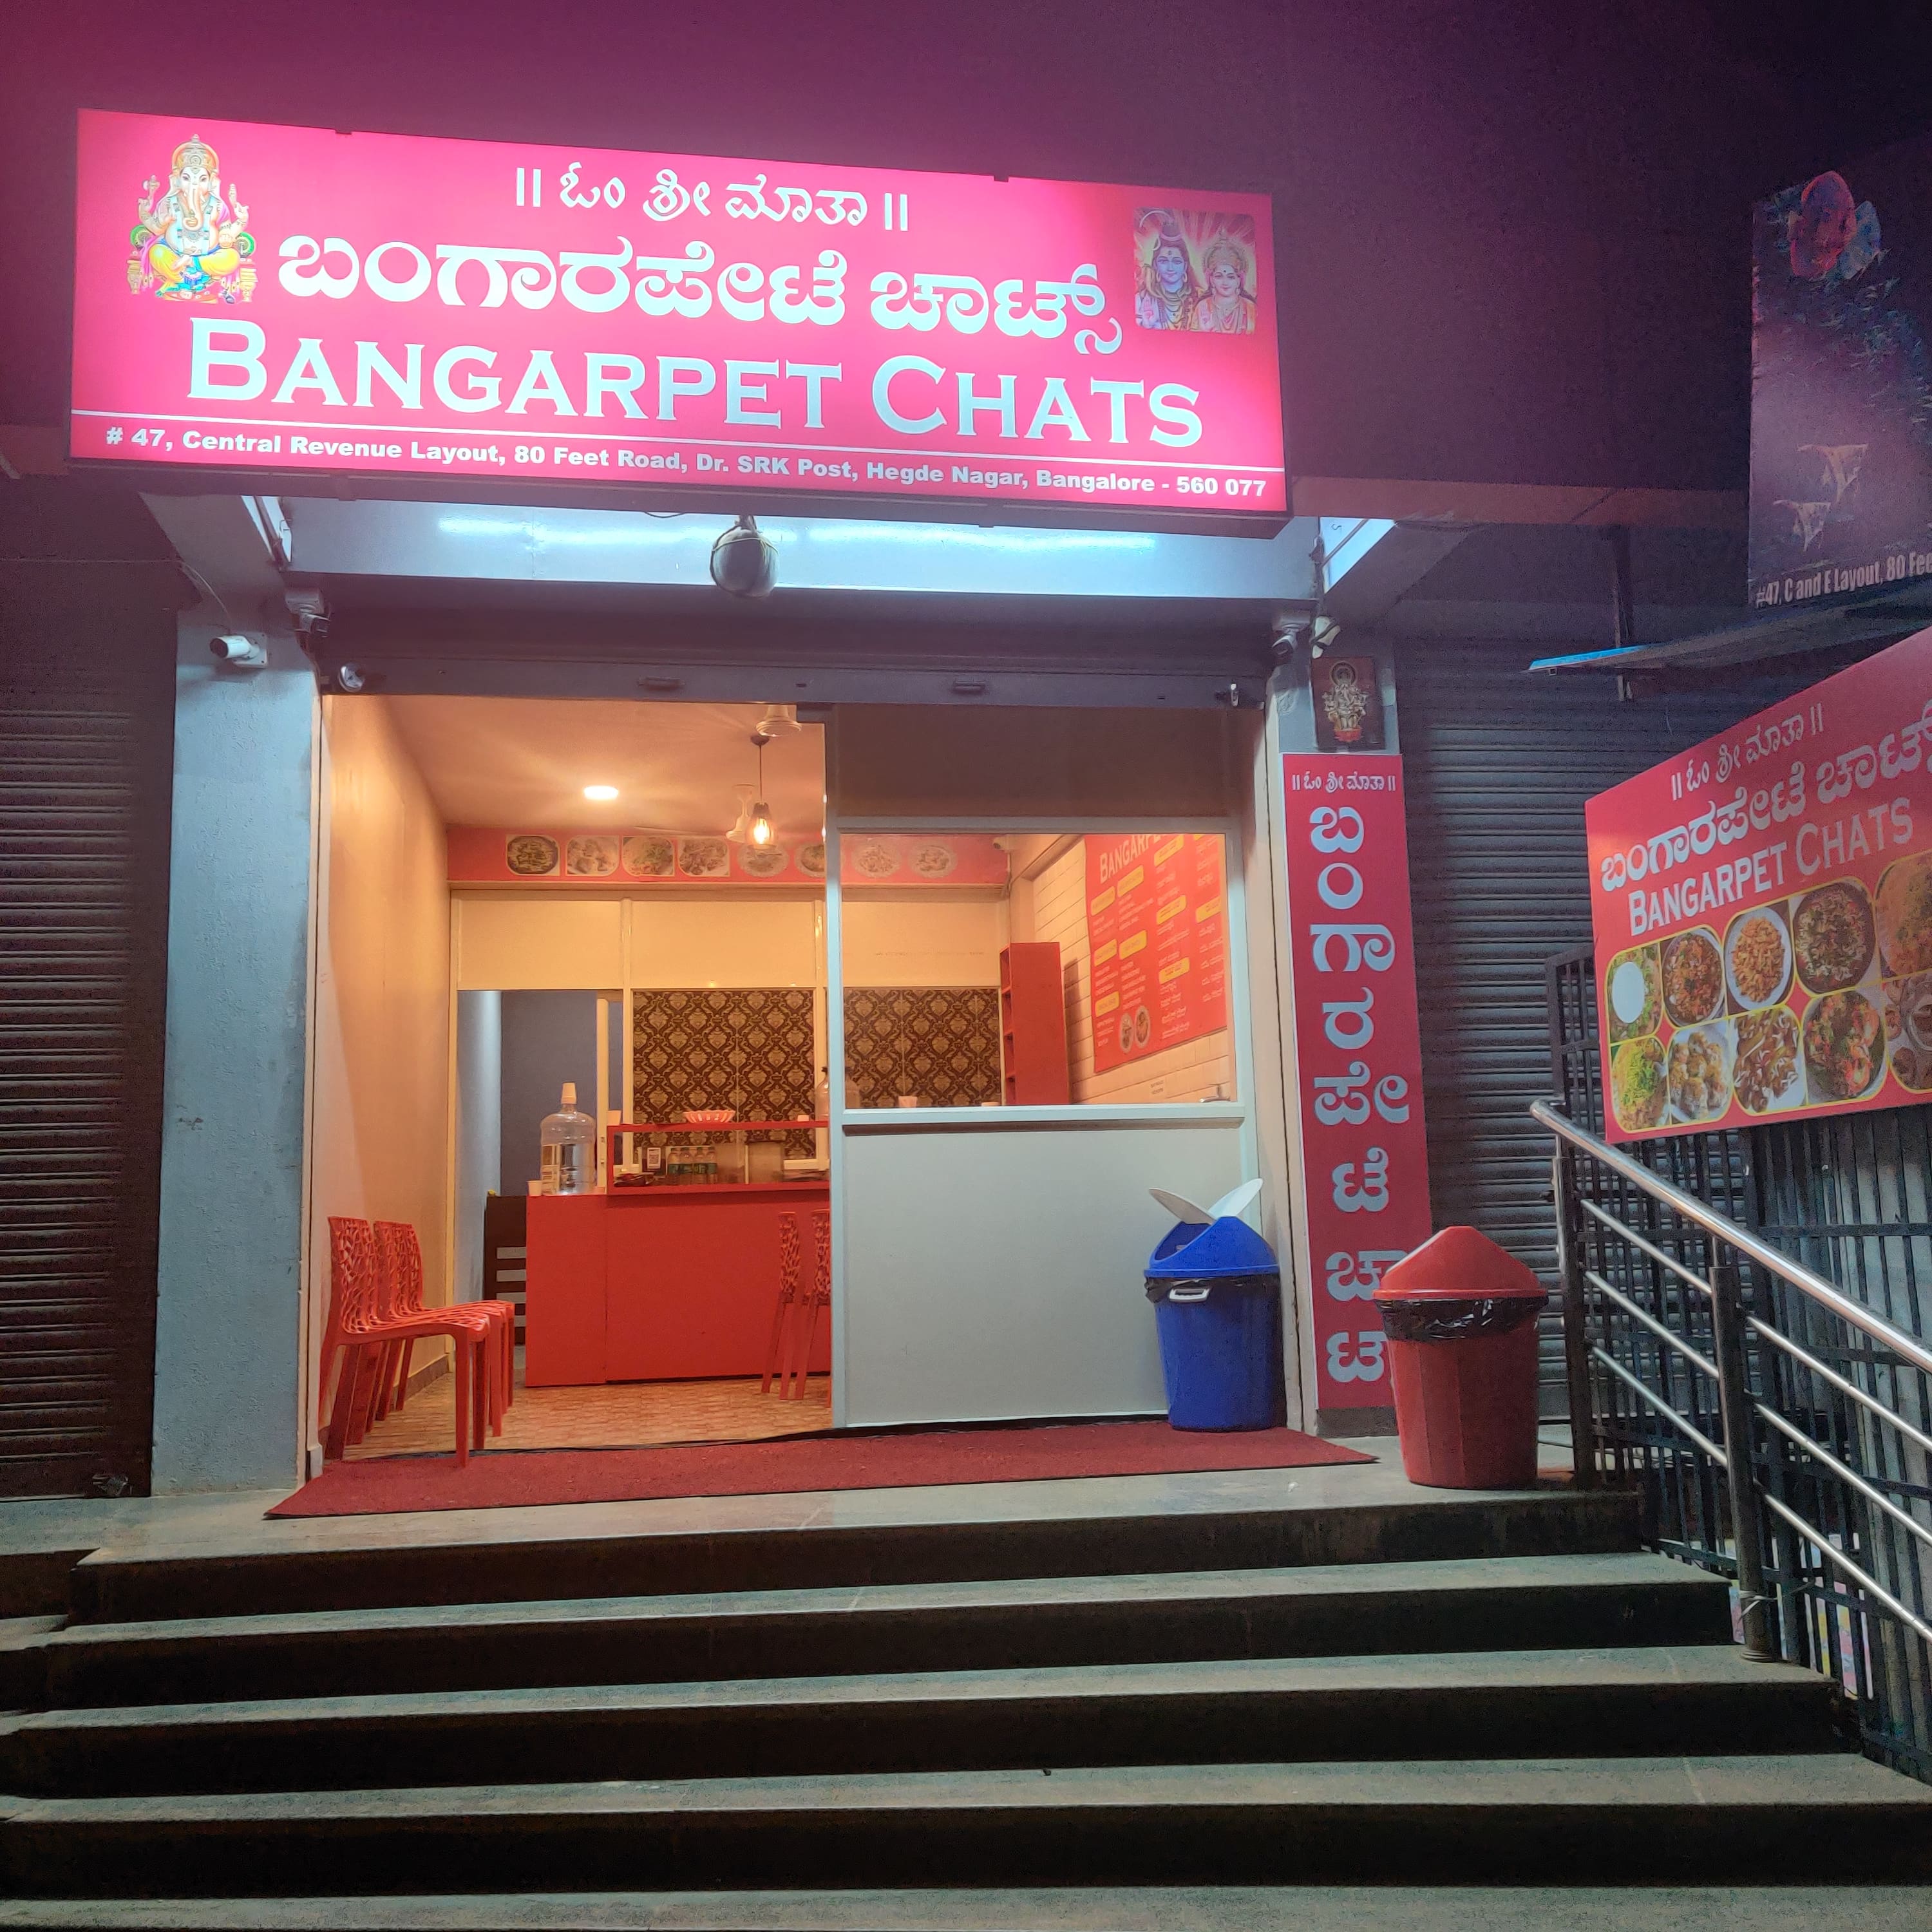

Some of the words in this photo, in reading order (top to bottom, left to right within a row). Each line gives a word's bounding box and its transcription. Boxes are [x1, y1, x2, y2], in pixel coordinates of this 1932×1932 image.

[559, 162, 626, 209] ಓಂ
[643, 169, 712, 222] ಶ್ರೀ
[725, 173, 868, 227] ಮಾತಾ
[278, 234, 848, 327] ಬಂಗಾರಪೇಟೆ
[869, 263, 1123, 355] ಚಾಟ್ಸ್
[187, 316, 842, 429] BANGARPET
[871, 354, 1204, 448] CHATS
[131, 428, 173, 453] 47,
[182, 430, 281, 454] Central
[290, 435, 402, 459] Revenue
[411, 440, 506, 467] Layout,
[514, 445, 545, 465] 80
[554, 446, 609, 468] Feet
[618, 450, 688, 475] Road,
[696, 453, 729, 473] Dr.
[737, 455, 790, 475] SRK
[798, 459, 858, 482] Post,
[867, 462, 943, 486] Hegde
[952, 466, 1028, 490] Nagar,
[1036, 469, 1155, 495] Bangalore
[1177, 475, 1218, 495] 560
[1224, 478, 1266, 498] 077
[1795, 571, 1822, 600] and
[1887, 554, 1906, 581] 80
[1601, 760, 1806, 892] ಬಂಗಾರಪೇಟೆ
[1628, 841, 1787, 936] BANGARPET
[1795, 797, 1913, 876] CHATS
